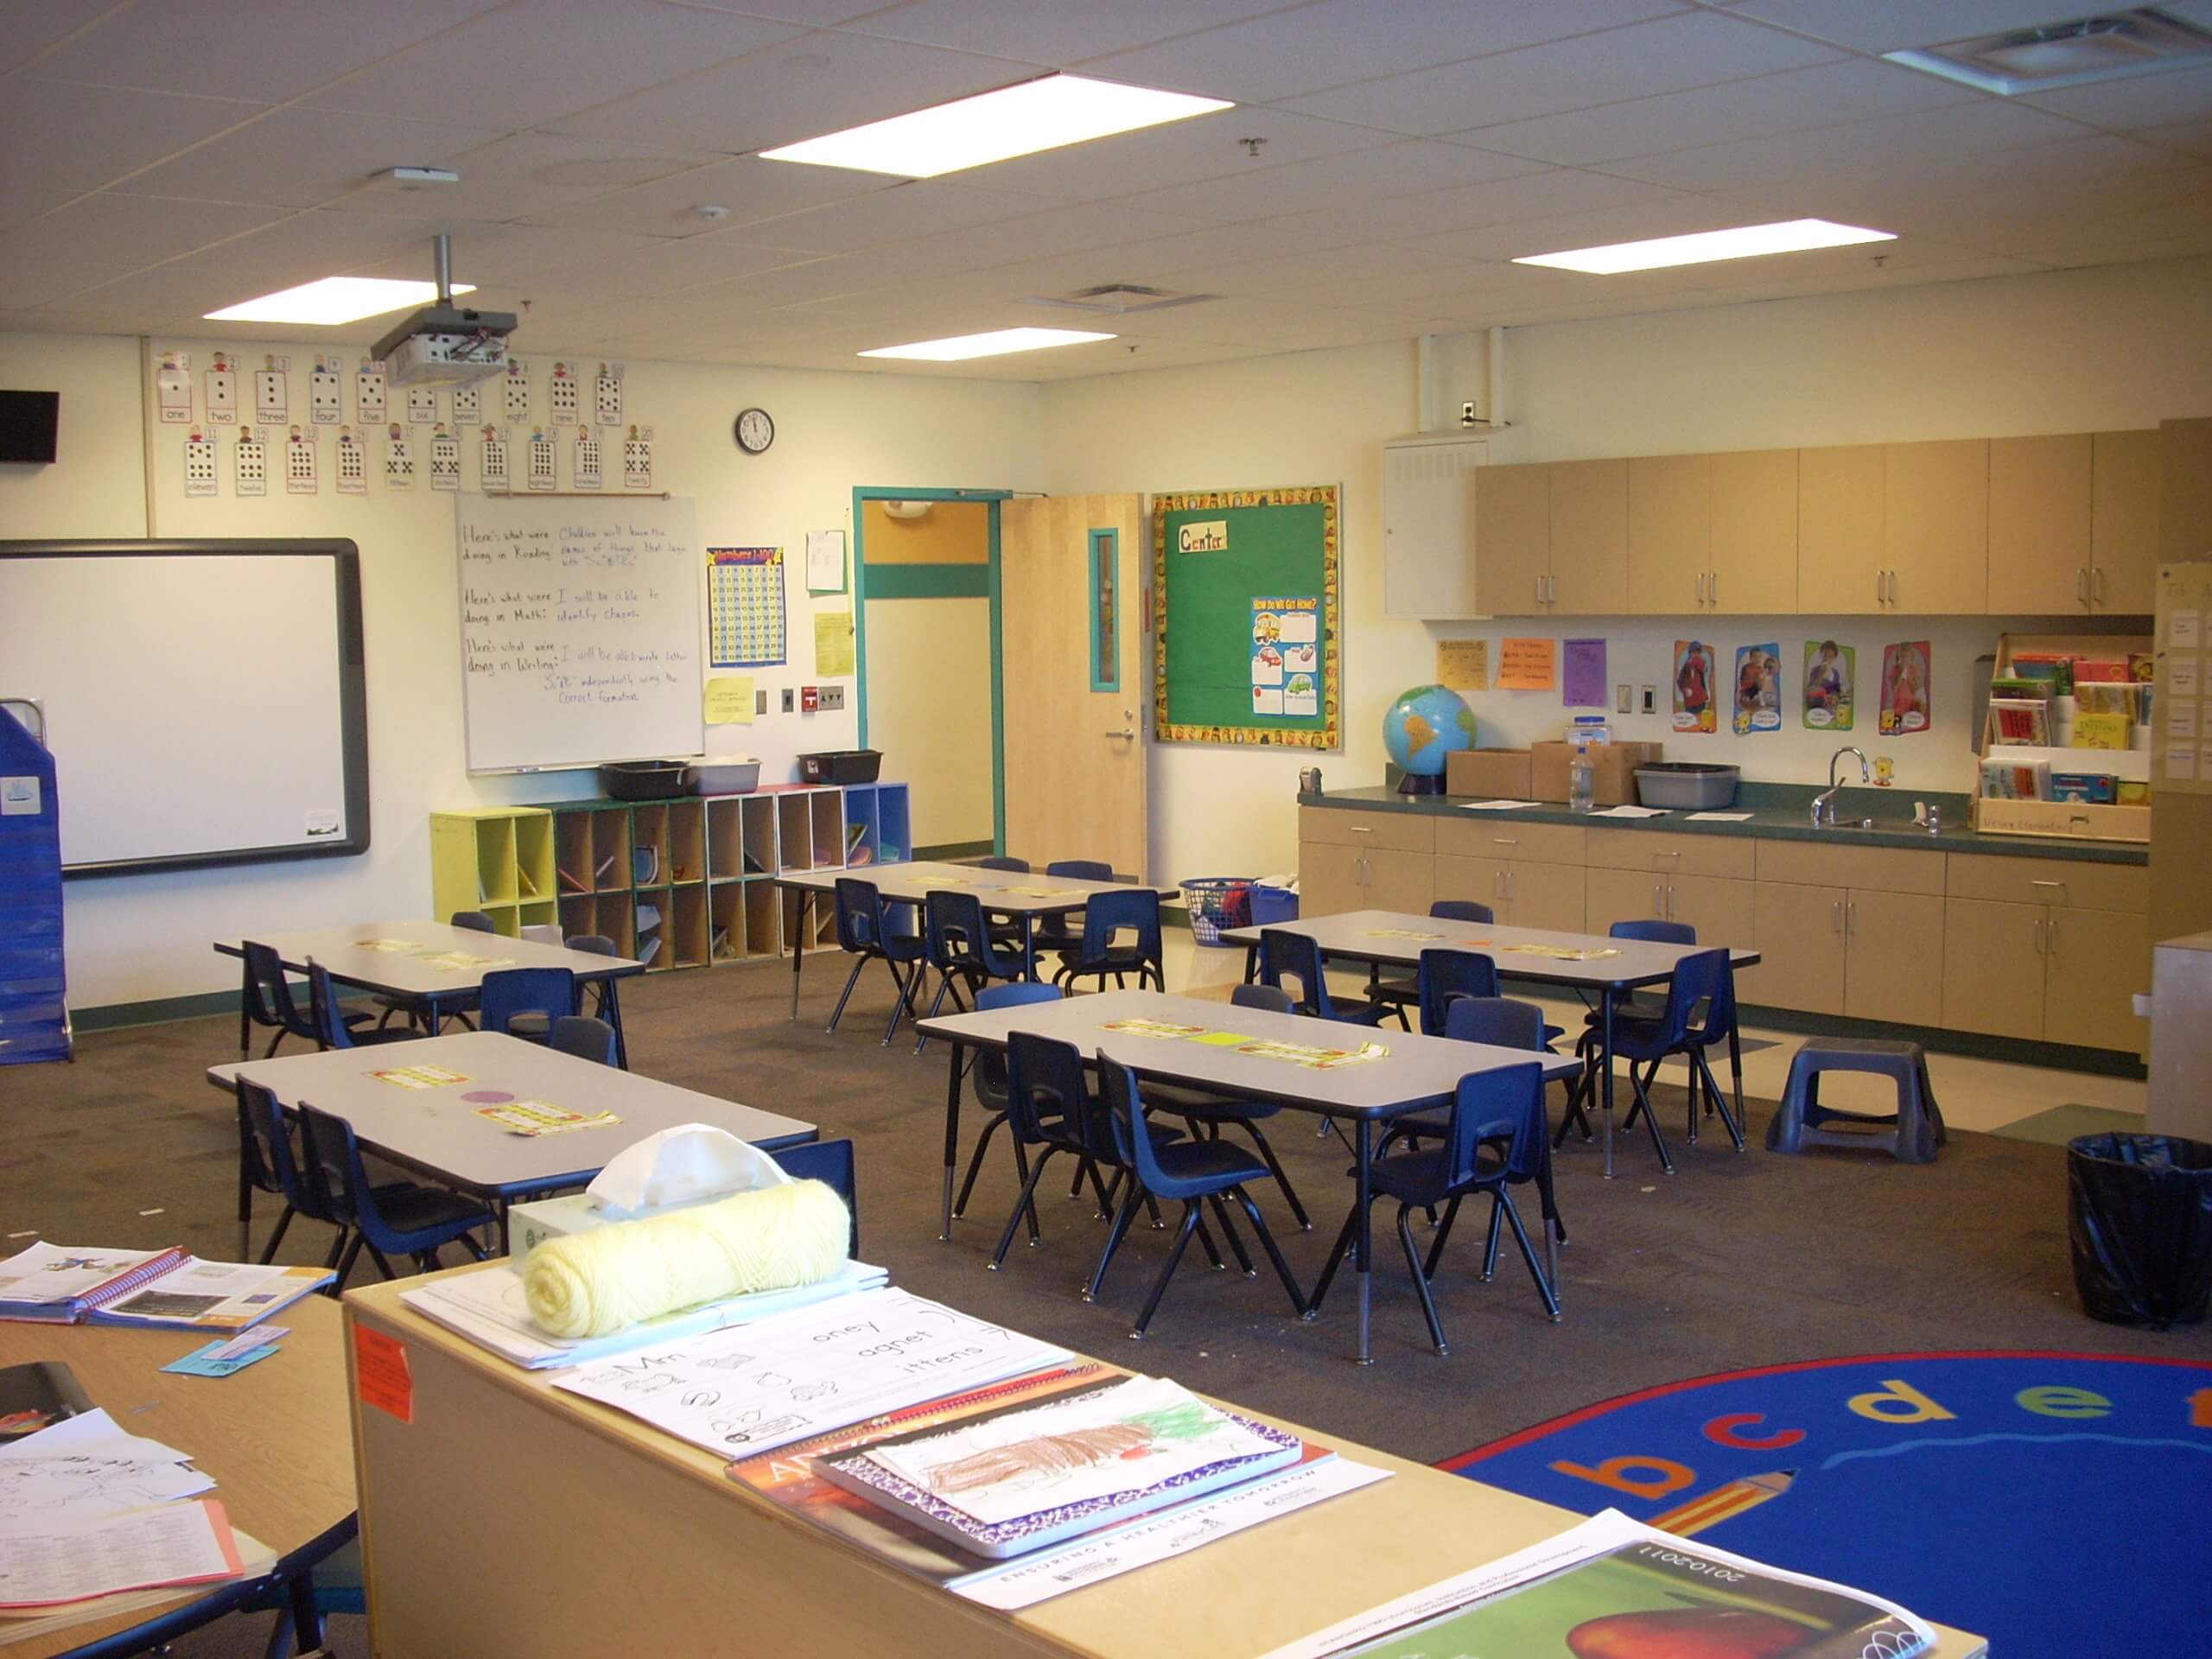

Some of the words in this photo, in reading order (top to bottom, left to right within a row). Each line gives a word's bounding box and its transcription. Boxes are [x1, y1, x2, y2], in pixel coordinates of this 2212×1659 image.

[166, 410, 185, 419] one
[212, 412, 232, 422] two
[258, 411, 285, 422] three
[315, 412, 337, 422] four
[363, 412, 381, 422] five
[454, 413, 477, 422] seven
[507, 412, 527, 423] eight
[556, 414, 573, 423] nine
[602, 413, 614, 423] ten
[188, 481, 215, 492] eleven
[503, 530, 524, 540] what
[1180, 528, 1223, 550] Center
[715, 549, 752, 562] Numbers
[753, 549, 775, 562] 1-100
[465, 588, 496, 605] Here's
[500, 592, 523, 602] what
[574, 589, 593, 602] will
[596, 591, 608, 601] be
[500, 641, 524, 652] what
[576, 645, 594, 660] will
[598, 647, 611, 661] be
[500, 662, 511, 671] in
[813, 1321, 880, 1343] oney
[858, 1330, 934, 1357] agnet
[613, 1354, 686, 1374] Mm
[903, 1345, 983, 1373] ittens
[1847, 1379, 1958, 1424] d
[2015, 1385, 2113, 1419] e
[1703, 1413, 1806, 1451] c
[1549, 1455, 1696, 1500] b
[1000, 1546, 1097, 1583] ENSURING
[1122, 1504, 1217, 1541] HEALTHIER
[1224, 1469, 1317, 1504] TOMORROW
